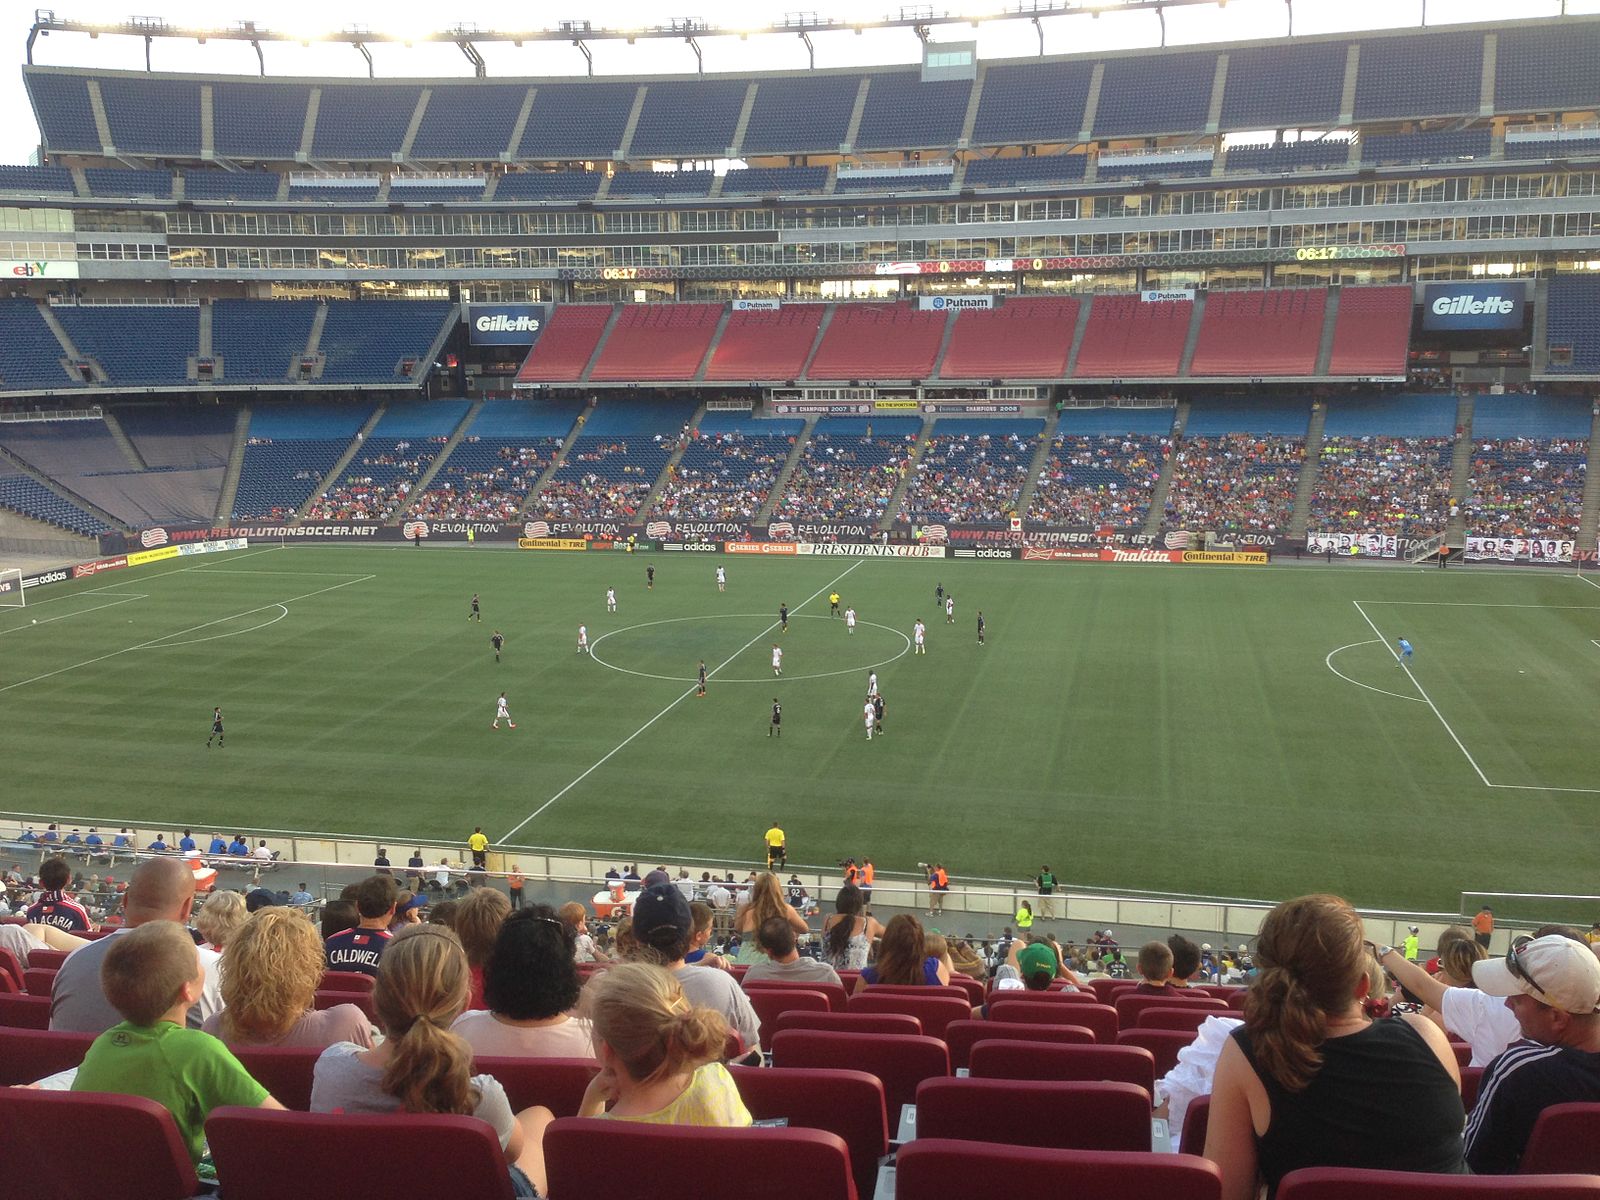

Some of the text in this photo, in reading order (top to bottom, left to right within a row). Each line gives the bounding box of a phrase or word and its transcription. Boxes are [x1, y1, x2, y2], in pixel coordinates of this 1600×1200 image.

[1297, 246, 1338, 260] 06:17
[603, 268, 637, 280] 06:17
[946, 298, 988, 307] Putnam
[1432, 295, 1514, 315] Gillette
[476, 315, 539, 332] Gillette
[171, 526, 378, 540] WWW.REVOLUTIONSOCCER.NET
[553, 523, 619, 533] REVOLUTION
[675, 523, 741, 533] REVOLUTION
[798, 525, 866, 536] REVOLUTION
[519, 539, 560, 548] Continental
[684, 542, 716, 551] adidas
[812, 544, 930, 557] PRESIDENTS CLUB
[977, 549, 1012, 558] adidas
[1183, 551, 1235, 562] Continental
[39, 571, 67, 584] adidas
[791, 888, 800, 897] 92
[330, 949, 381, 968] CALDWEL
[1111, 969, 1124, 977] 27
